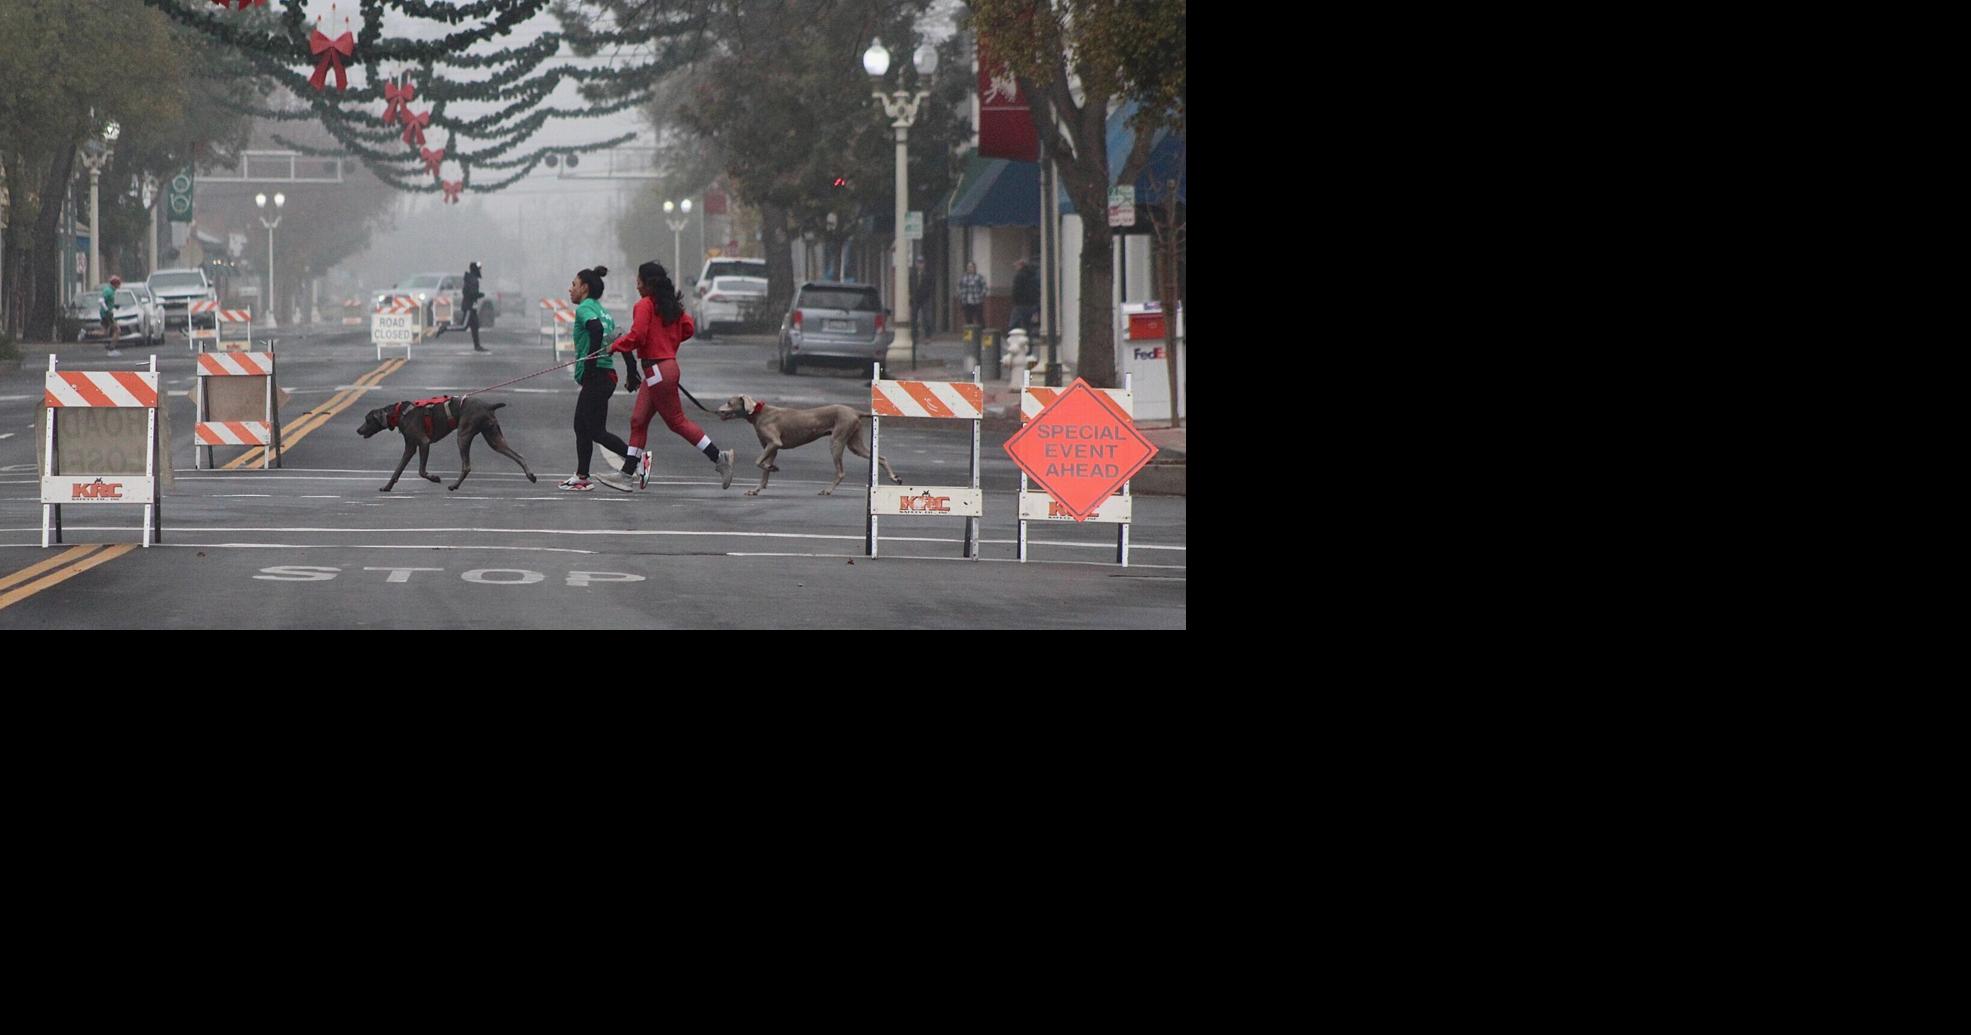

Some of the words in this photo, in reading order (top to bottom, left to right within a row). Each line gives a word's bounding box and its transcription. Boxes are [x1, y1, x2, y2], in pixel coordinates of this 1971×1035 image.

[379, 317, 405, 328] ROAD
[374, 329, 410, 340] CLOSED
[1134, 347, 1168, 360] FedE
[1037, 424, 1127, 441] SPECIAL
[1044, 443, 1118, 459] EVENT
[1046, 463, 1119, 478] AHEAD
[72, 483, 122, 498] KRC
[252, 565, 647, 587] STOP
